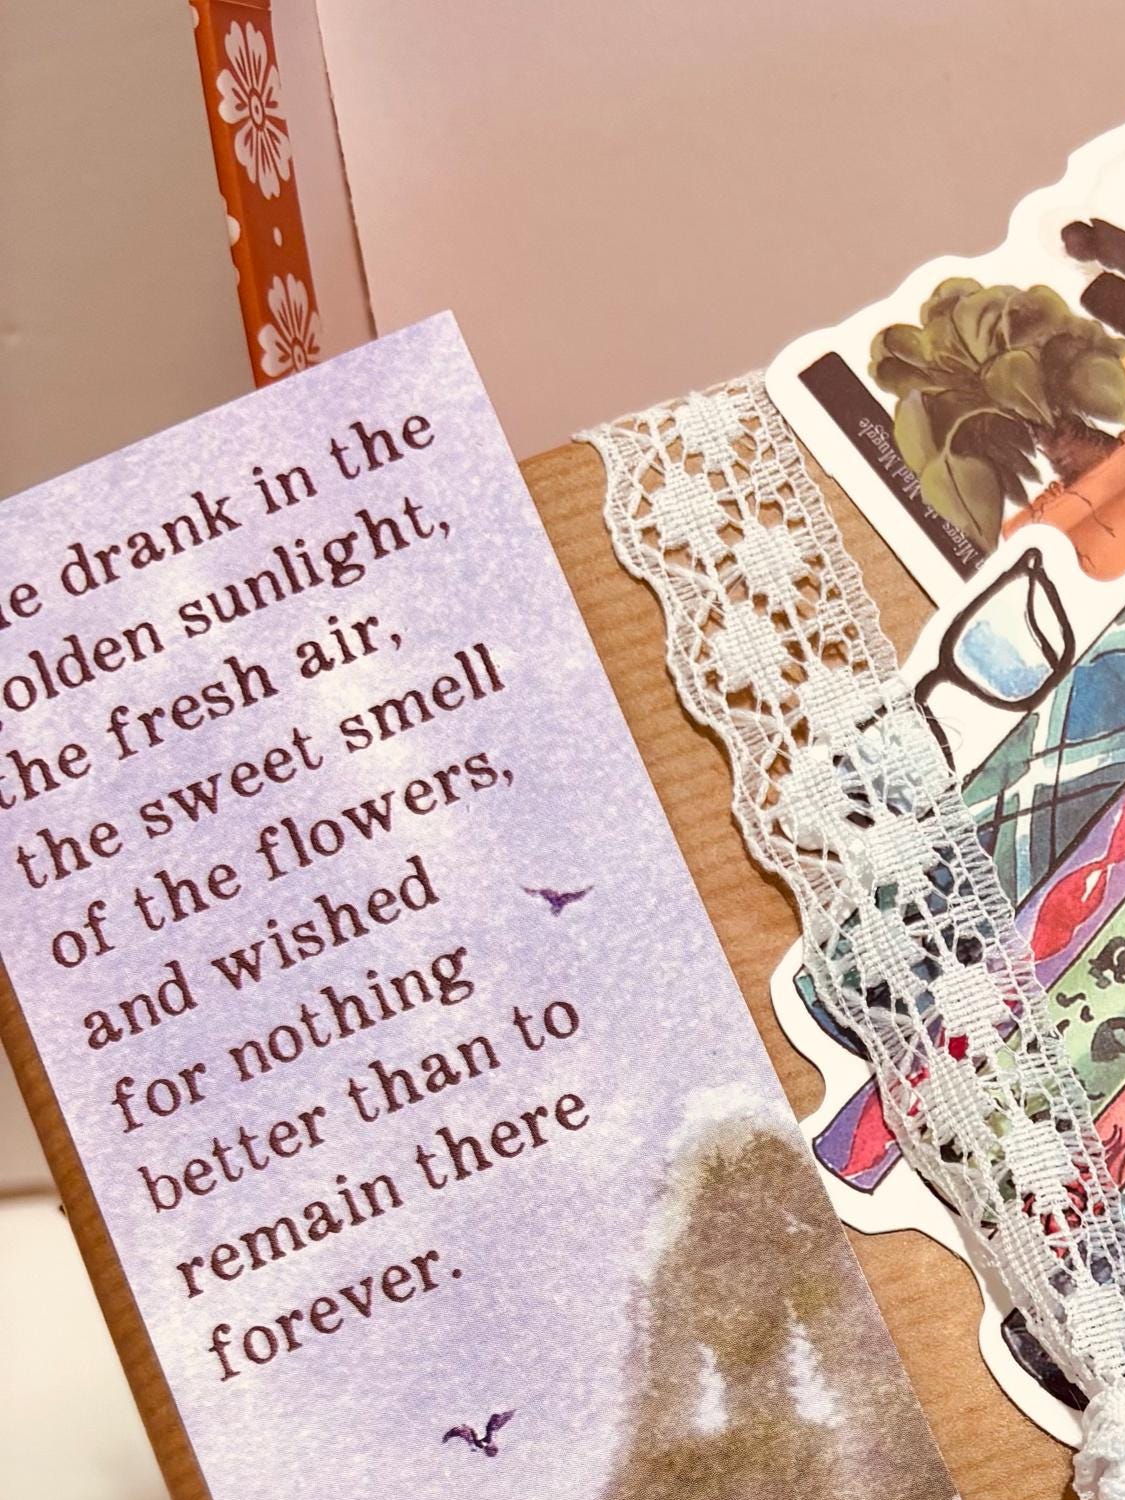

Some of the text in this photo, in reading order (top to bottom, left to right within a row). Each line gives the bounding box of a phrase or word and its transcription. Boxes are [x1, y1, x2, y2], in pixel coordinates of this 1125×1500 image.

[0, 415, 435, 630] e drank in the
[858, 417, 901, 470] Muggle
[3, 497, 450, 712] olden sunlight,
[107, 656, 279, 760] fresh
[296, 616, 401, 678] air,
[17, 643, 505, 888] the sweet smell
[52, 753, 513, 968] of the flowers,
[84, 855, 440, 1050] and wished
[111, 946, 474, 1133] for nothing
[137, 1001, 580, 1213] better than to
[176, 1094, 590, 1298] remain there
[208, 1250, 462, 1382] forever.
